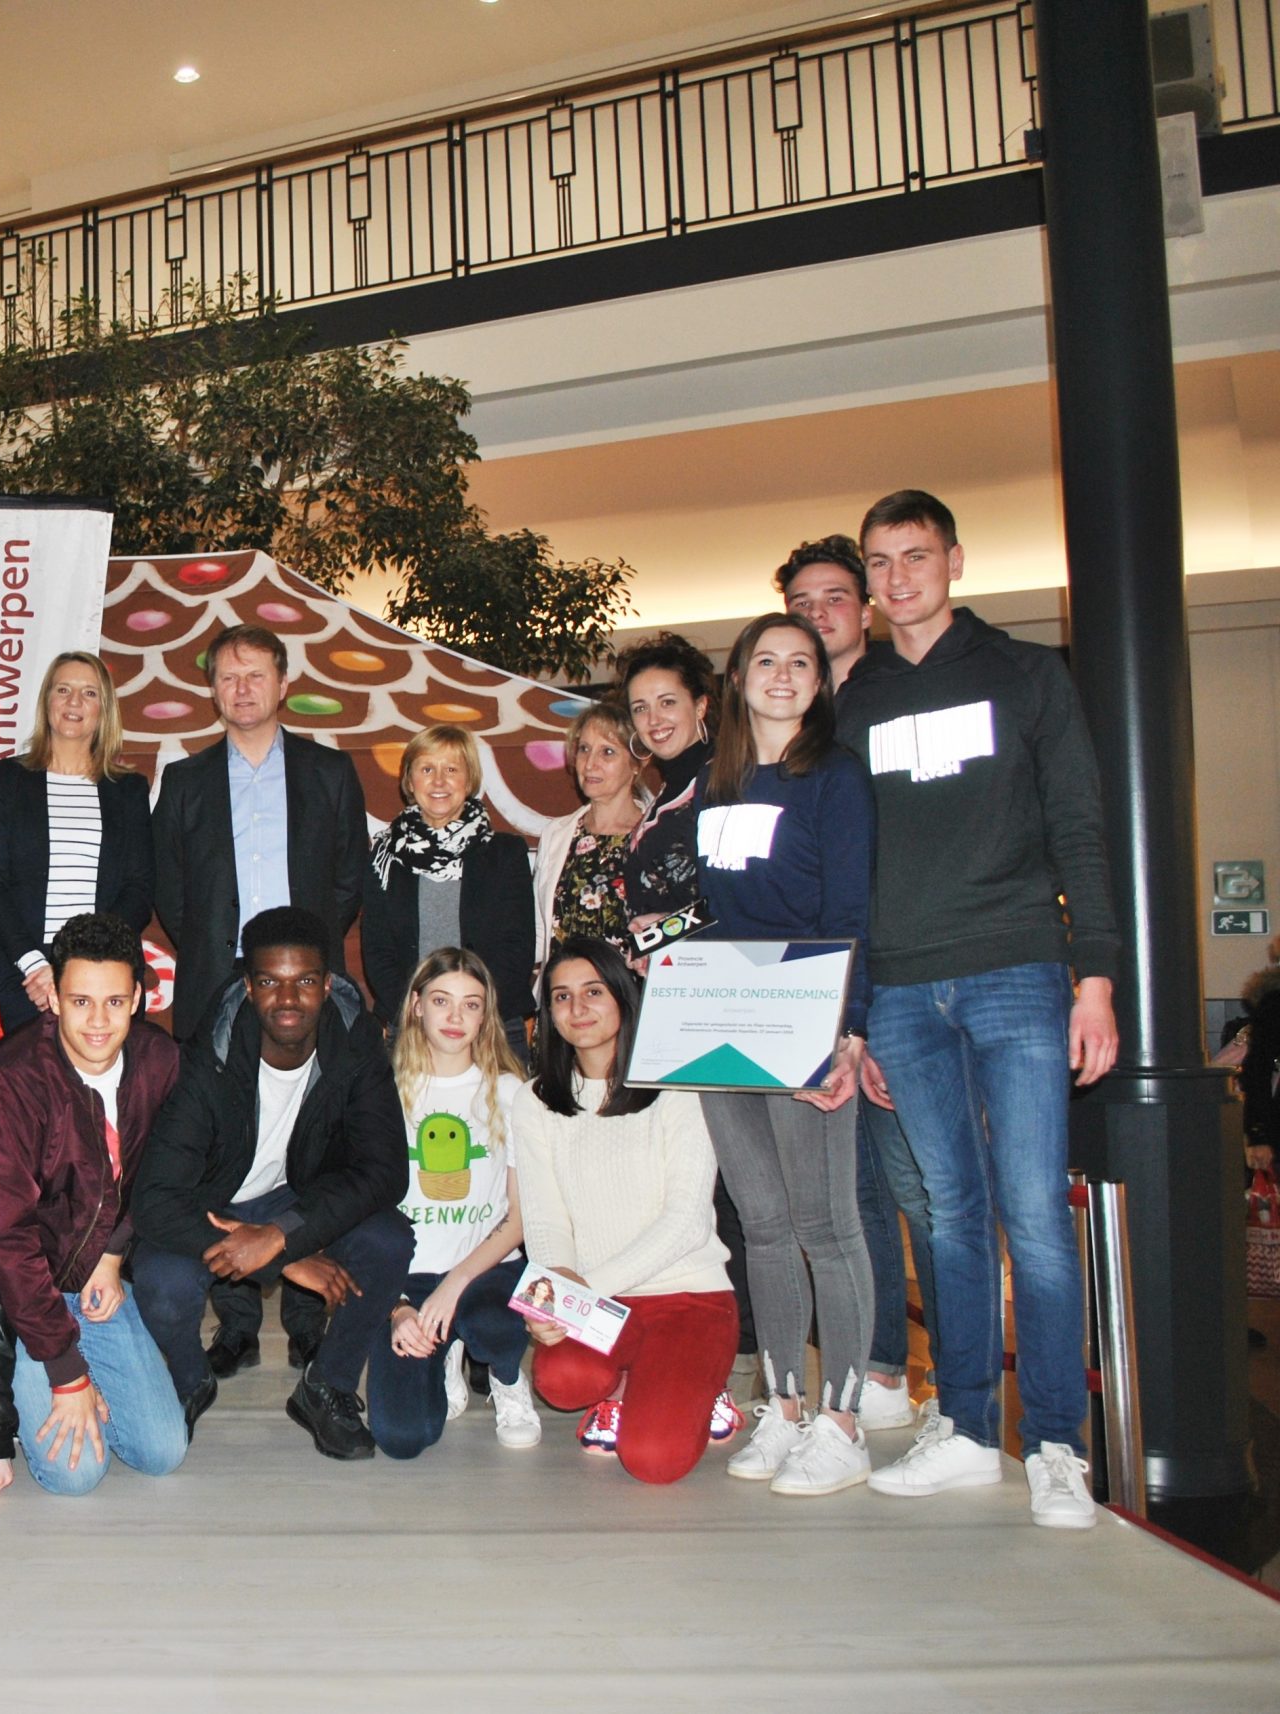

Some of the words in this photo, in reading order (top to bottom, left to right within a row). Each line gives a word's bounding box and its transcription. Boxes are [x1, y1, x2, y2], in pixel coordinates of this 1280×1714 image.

[651, 988, 687, 998] BESTE
[689, 988, 737, 998] JUNIOR
[740, 989, 839, 1000] ONDERNEMING
